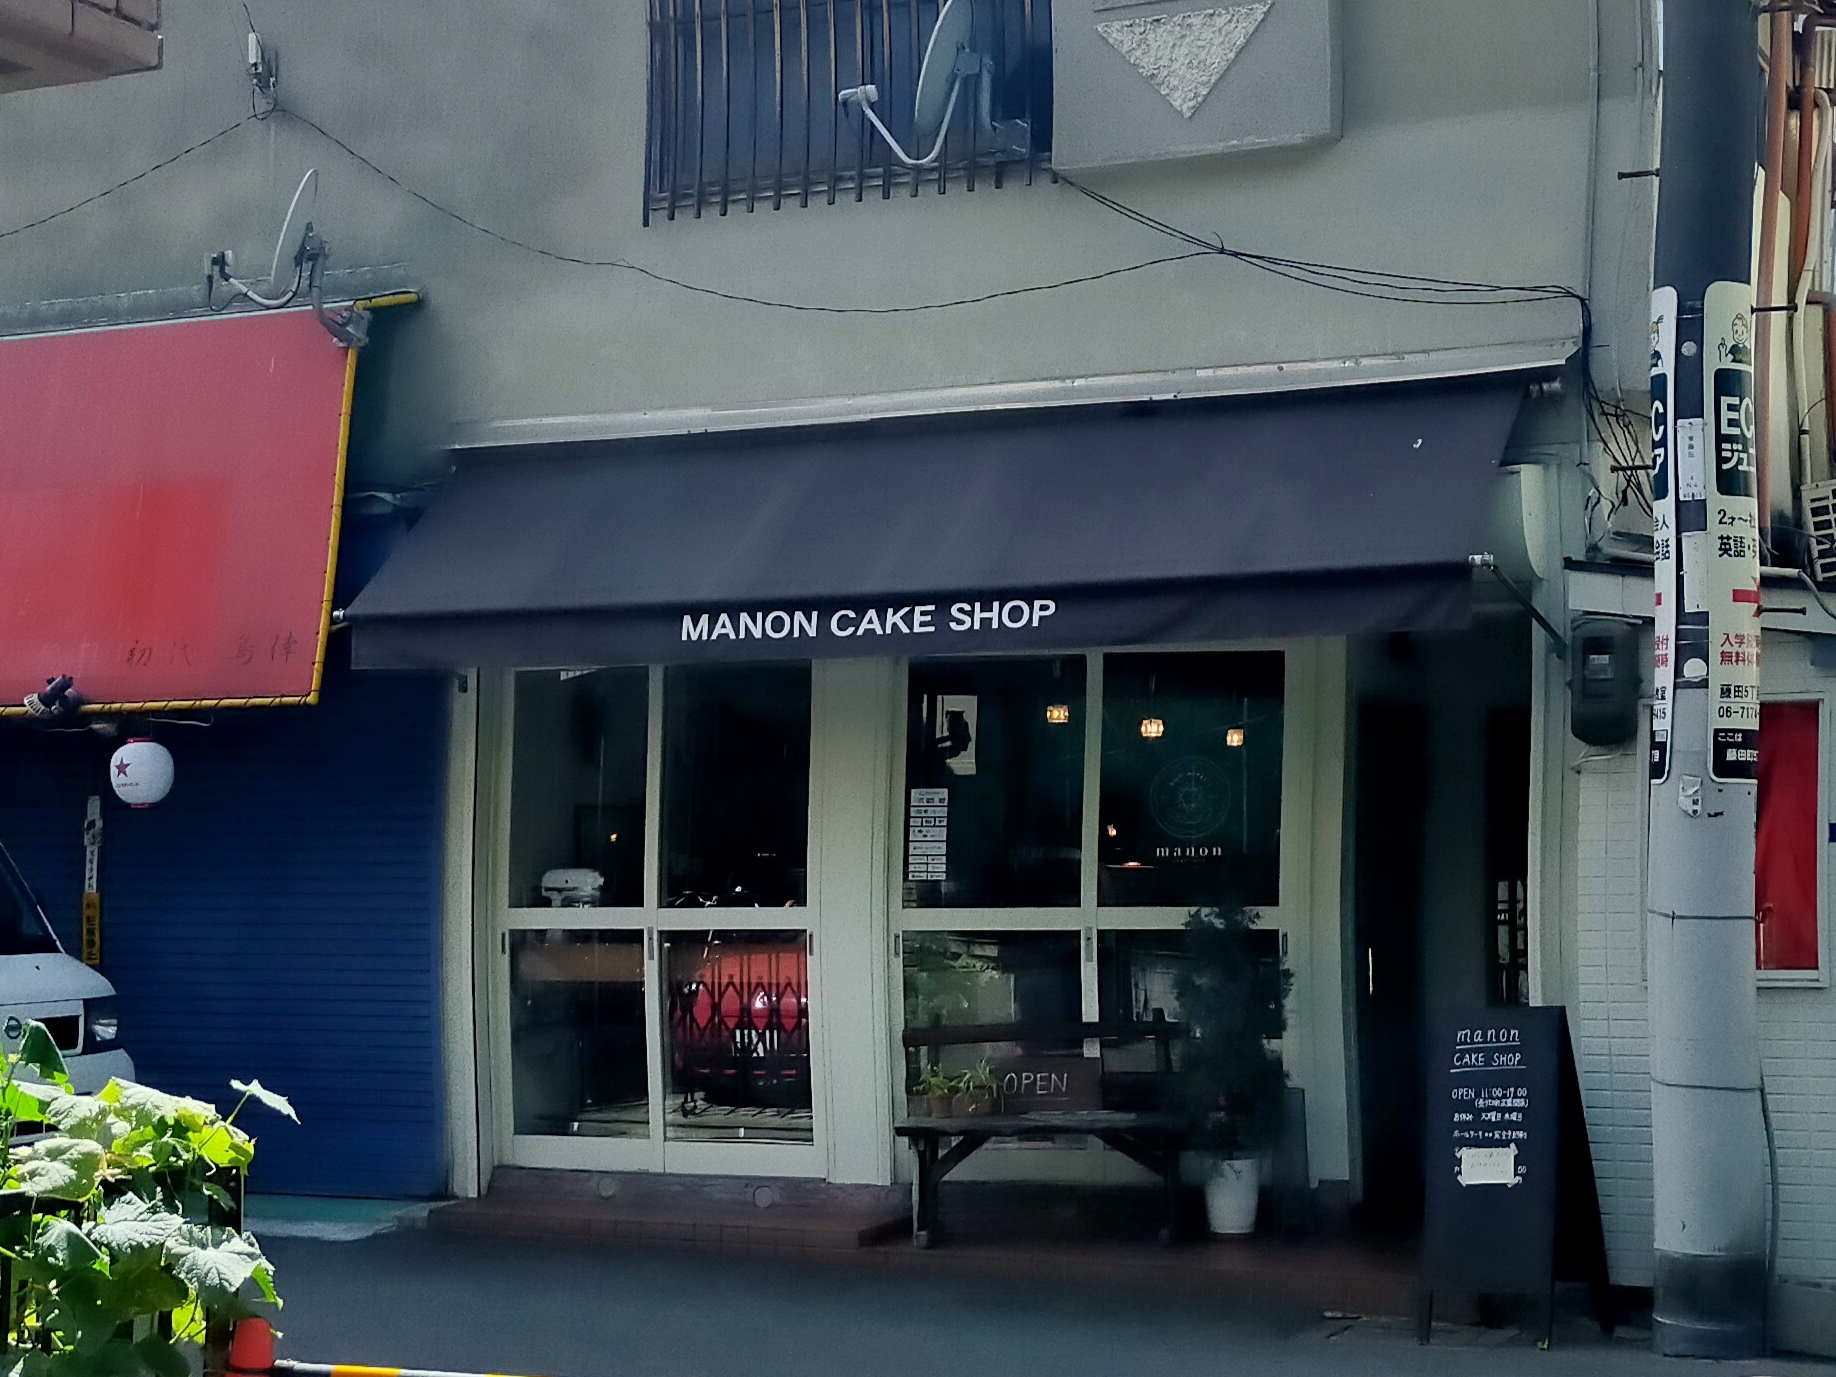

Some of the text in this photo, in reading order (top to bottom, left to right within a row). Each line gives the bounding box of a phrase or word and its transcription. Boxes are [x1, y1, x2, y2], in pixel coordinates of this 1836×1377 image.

[682, 600, 1056, 641] MANON CAKE SHOP
[1156, 846, 1222, 857] manon
[1456, 1028, 1520, 1043] manon
[1453, 1053, 1522, 1066] CAKE SHOP
[1003, 1072, 1068, 1095] OPEN
[1451, 1088, 1475, 1100] OPEN
